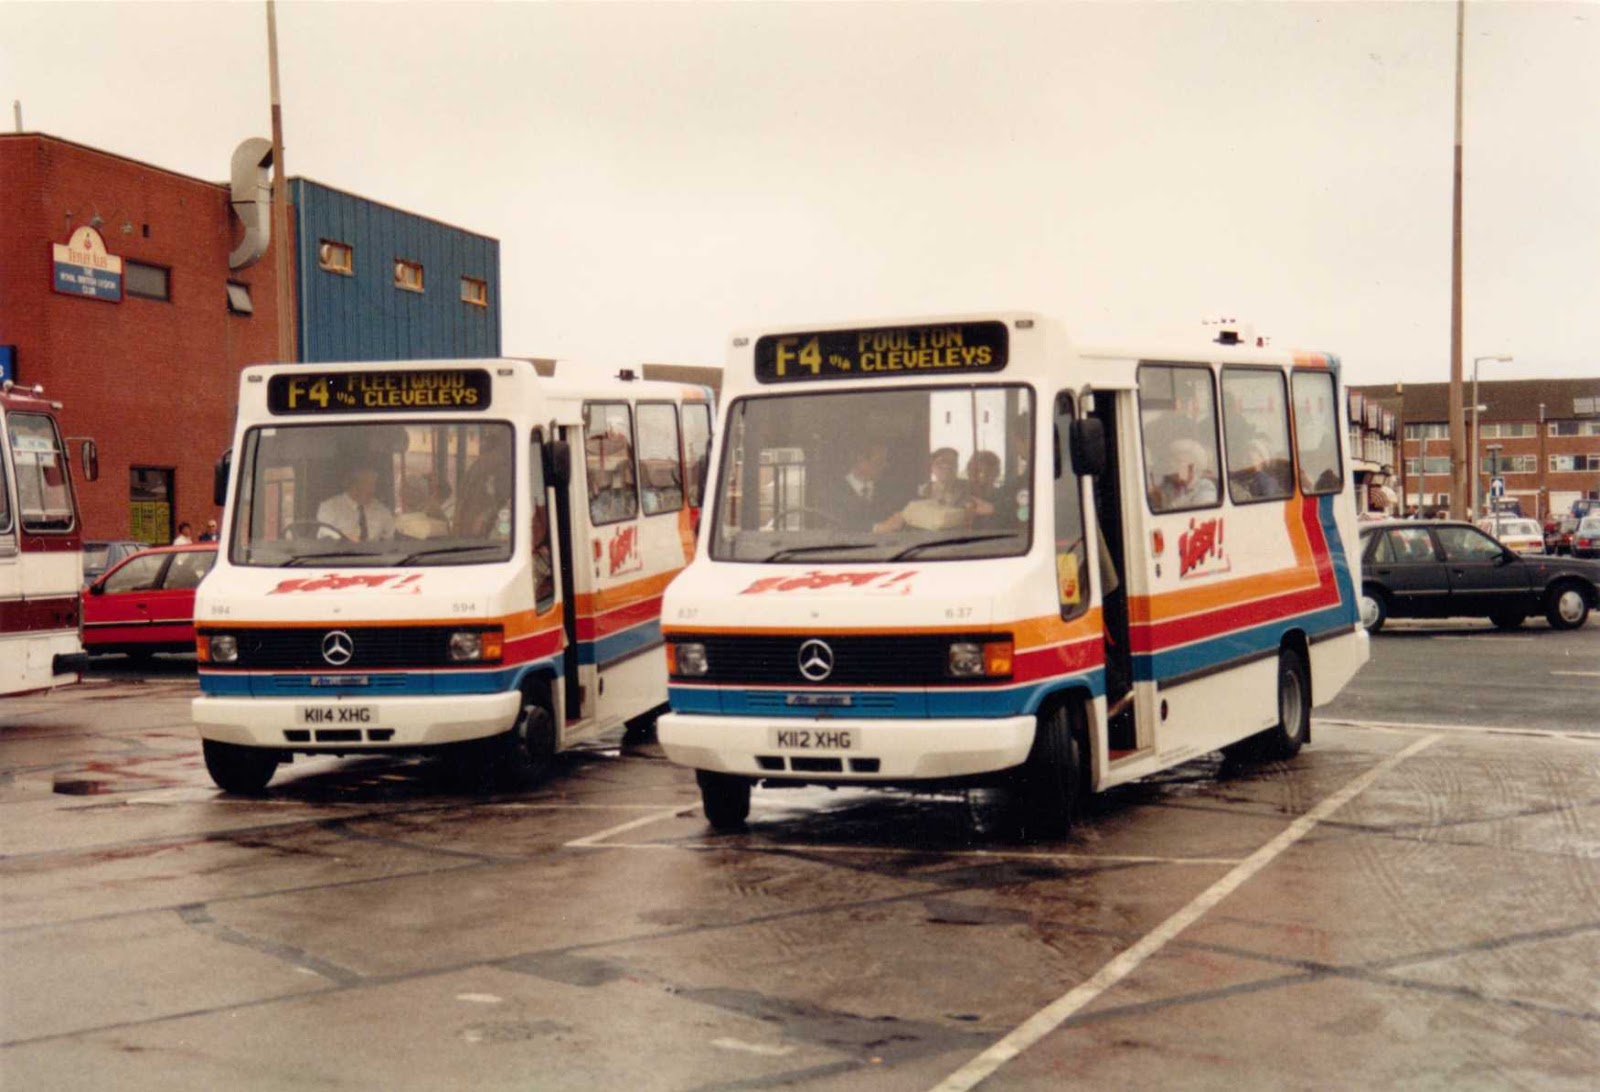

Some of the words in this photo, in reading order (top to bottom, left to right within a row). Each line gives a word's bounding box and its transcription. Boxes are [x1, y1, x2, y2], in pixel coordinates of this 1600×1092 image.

[858, 328, 963, 352] POULTON
[776, 336, 822, 376] F4
[860, 345, 992, 372] CLEVELEYS
[348, 373, 465, 391] FLEETWOOD
[288, 377, 330, 409] F4
[364, 388, 479, 406] CLEVELEYS
[452, 602, 477, 613] 594
[944, 606, 973, 620] 637
[304, 708, 334, 722] K114
[338, 708, 371, 722] XHG
[777, 731, 810, 748] K112
[815, 731, 851, 748] XHG
